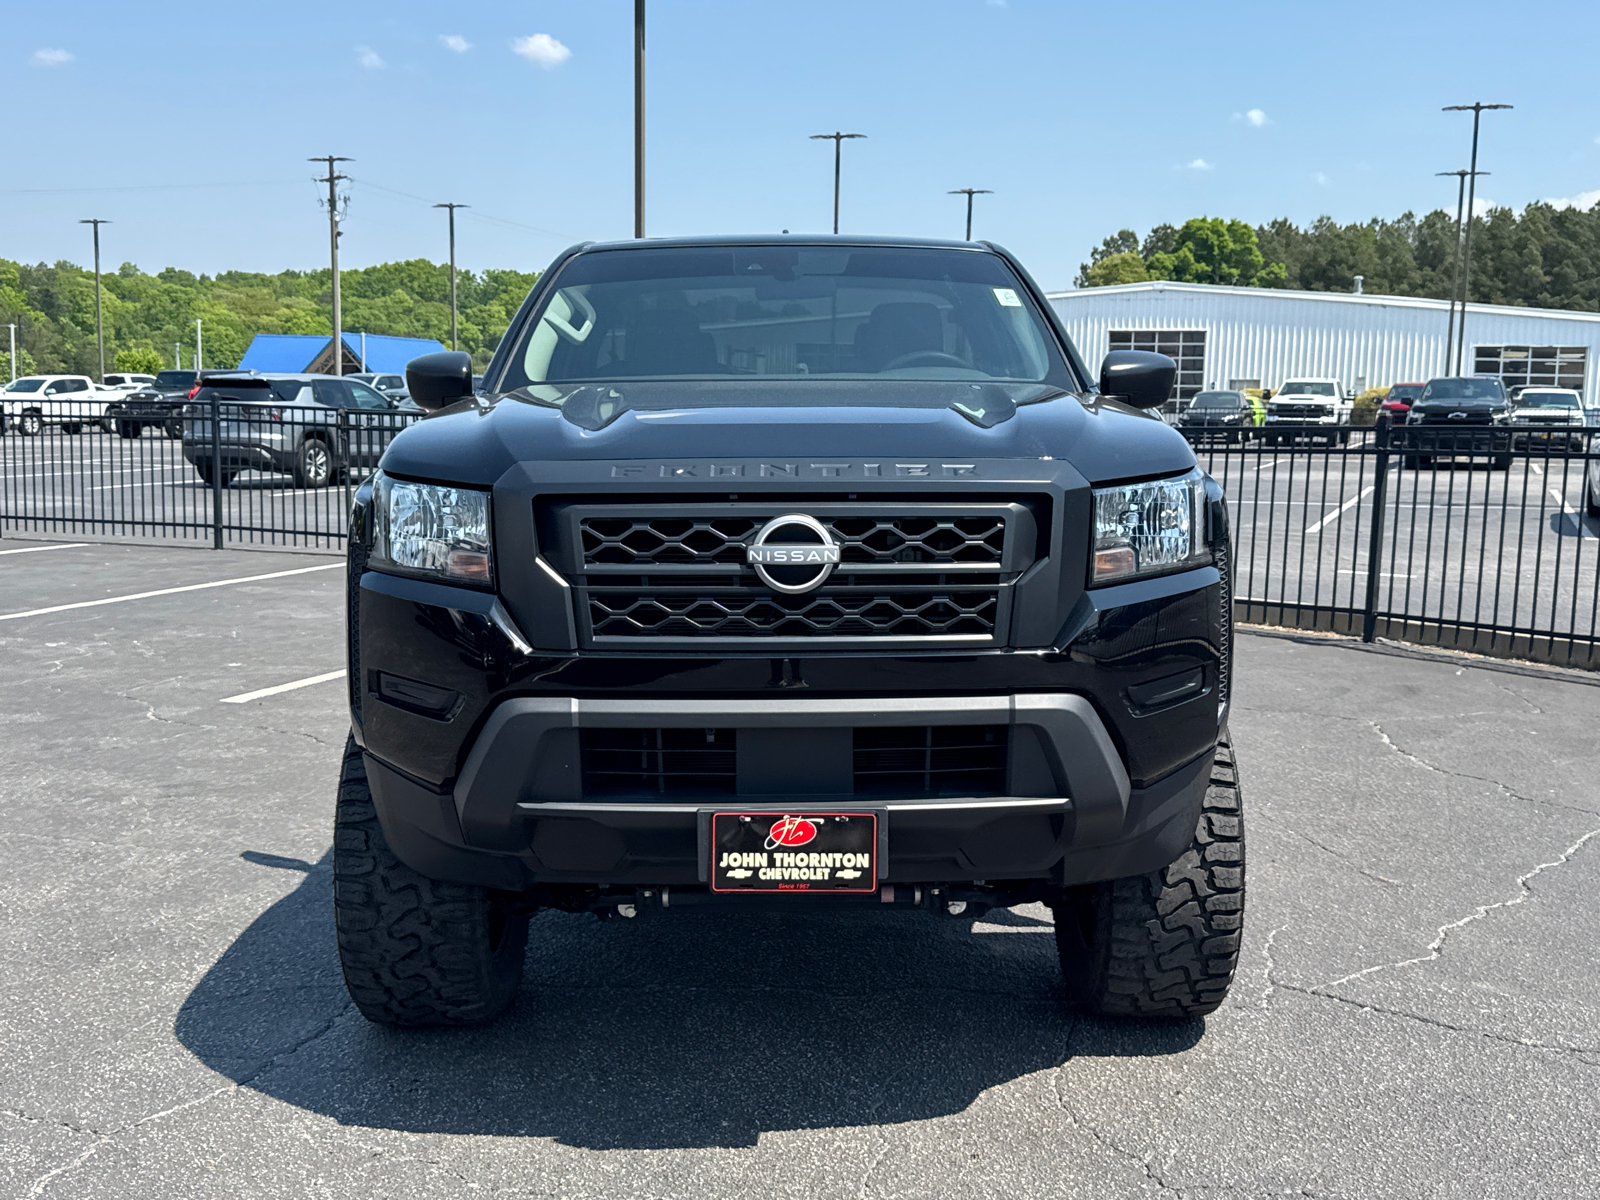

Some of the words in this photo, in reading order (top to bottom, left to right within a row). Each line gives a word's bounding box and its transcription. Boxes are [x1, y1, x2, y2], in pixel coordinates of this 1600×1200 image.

[611, 463, 979, 478] FRONTIER
[749, 550, 838, 562] NISSAN
[719, 852, 768, 868] JOHN
[773, 853, 869, 868] THORNTON
[758, 868, 831, 880] CHEVROLET
